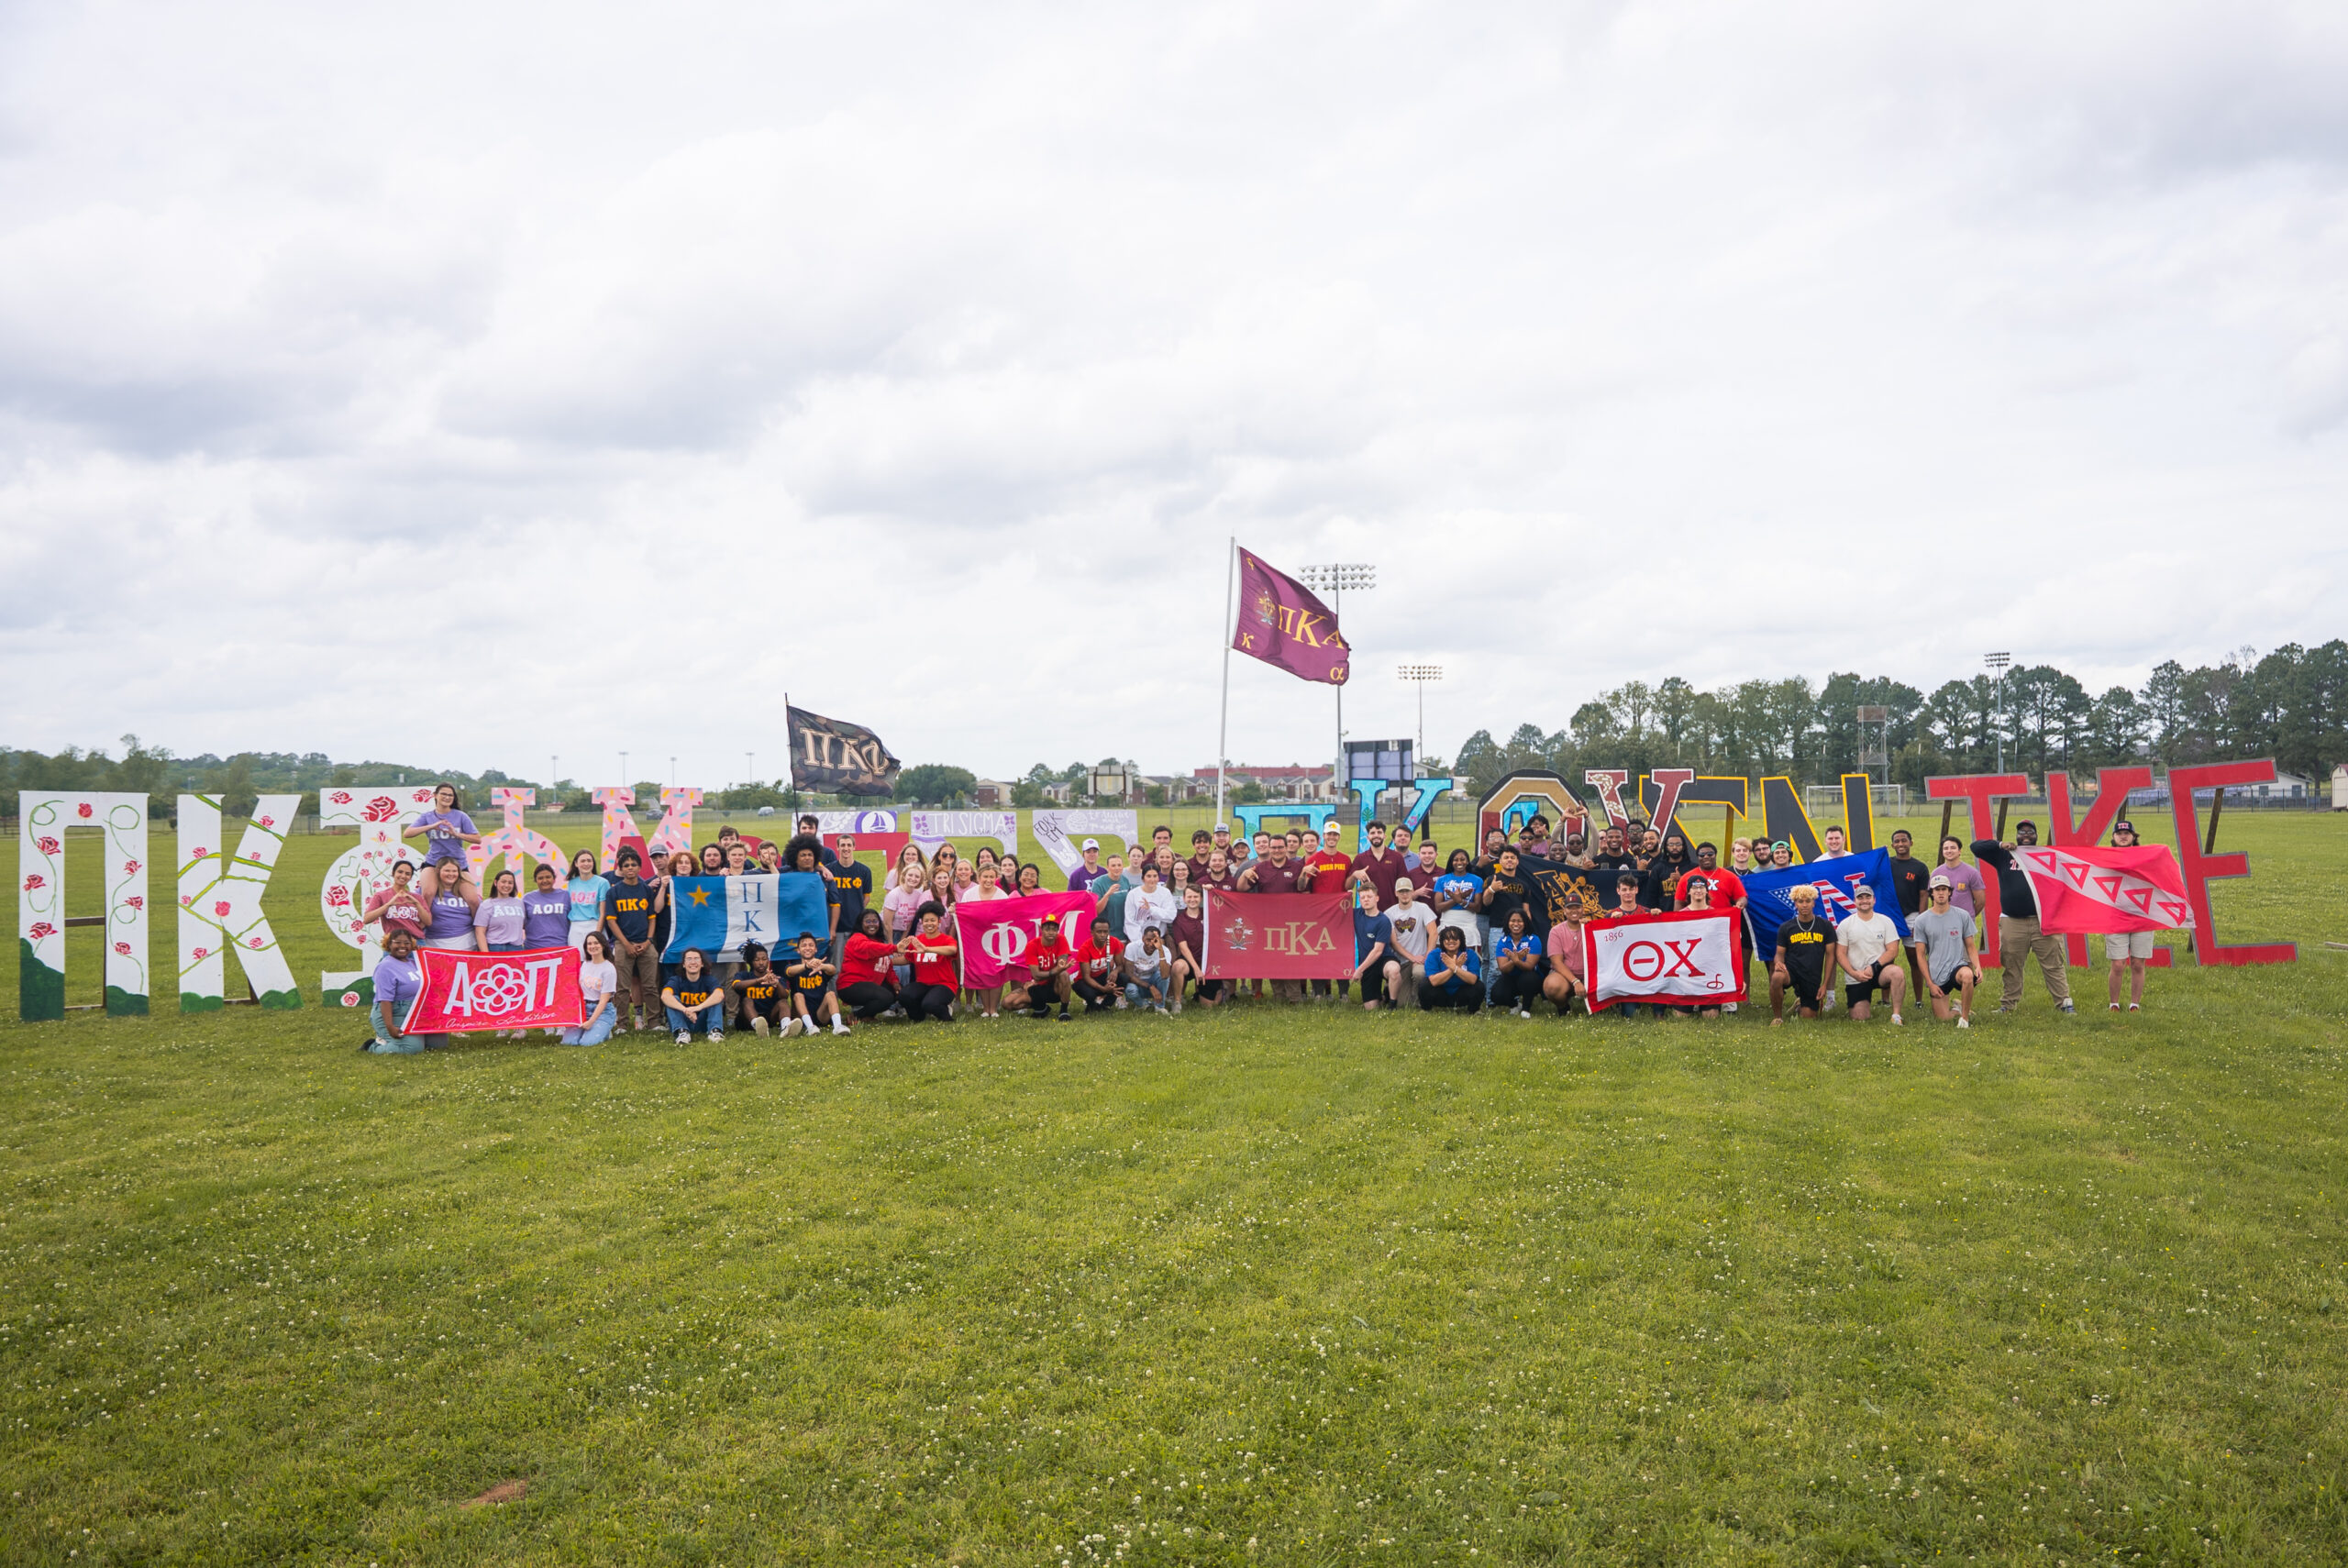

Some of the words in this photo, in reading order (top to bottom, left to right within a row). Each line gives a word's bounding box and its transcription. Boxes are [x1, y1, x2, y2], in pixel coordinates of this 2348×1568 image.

[1278, 603, 1346, 650] ΠΚΑ
[799, 726, 892, 776] ΠΚΦ
[928, 812, 955, 834] TRI
[958, 812, 1007, 835] SIGMA
[532, 902, 564, 915] ΑΟΠ
[615, 898, 648, 912] ΠΚΦ
[1264, 921, 1336, 955] ΠΚΑ
[1604, 929, 1623, 943] 1856
[1789, 932, 1812, 944] SIGMA
[1812, 932, 1823, 943] NU
[1623, 937, 1705, 982] ΘΧ
[799, 974, 823, 989] ΠΚΦ
